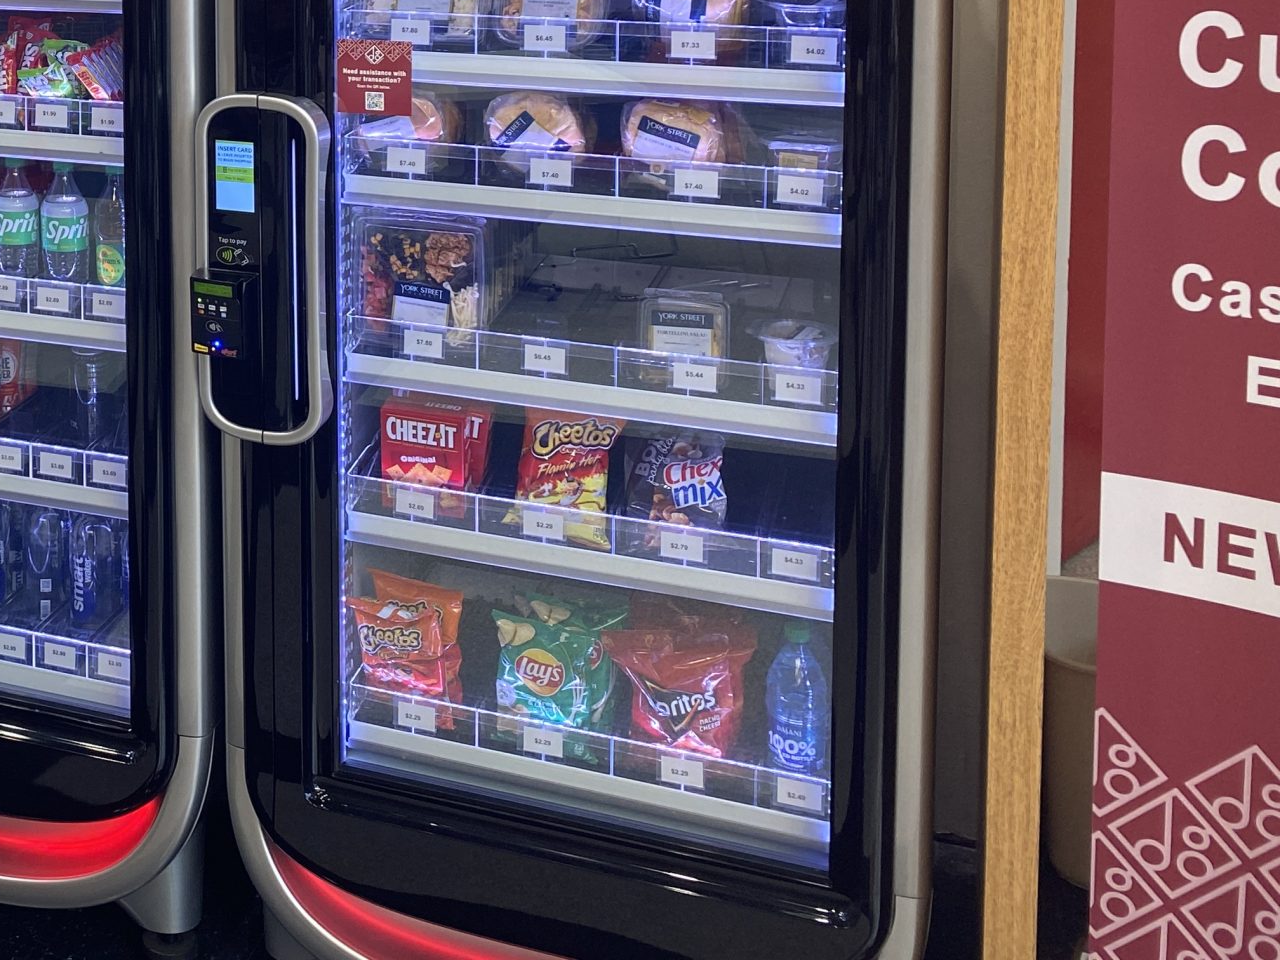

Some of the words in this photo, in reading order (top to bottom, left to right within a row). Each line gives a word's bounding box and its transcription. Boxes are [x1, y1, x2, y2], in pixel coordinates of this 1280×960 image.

[342, 67, 358, 75] Need
[362, 76, 401, 84] transaction?
[646, 119, 665, 133] YORK
[667, 128, 693, 144] STREET
[684, 182, 703, 190] $7.40
[790, 188, 809, 196] $4.02
[46, 218, 88, 244] Sprit
[218, 236, 229, 244] Tap
[400, 283, 418, 294] YORK
[420, 286, 443, 300] STREET
[1171, 263, 1280, 323] Cas
[657, 312, 679, 323] YORK
[680, 313, 706, 326] STREET
[533, 420, 617, 459] Cheetos
[579, 455, 600, 467] Hot
[664, 456, 723, 485] Chex
[673, 477, 724, 507] mix
[83, 558, 93, 584] water
[73, 556, 84, 613] smart
[359, 624, 421, 655] Cheetos
[655, 691, 716, 718] oritos
[768, 730, 816, 756] 100%
